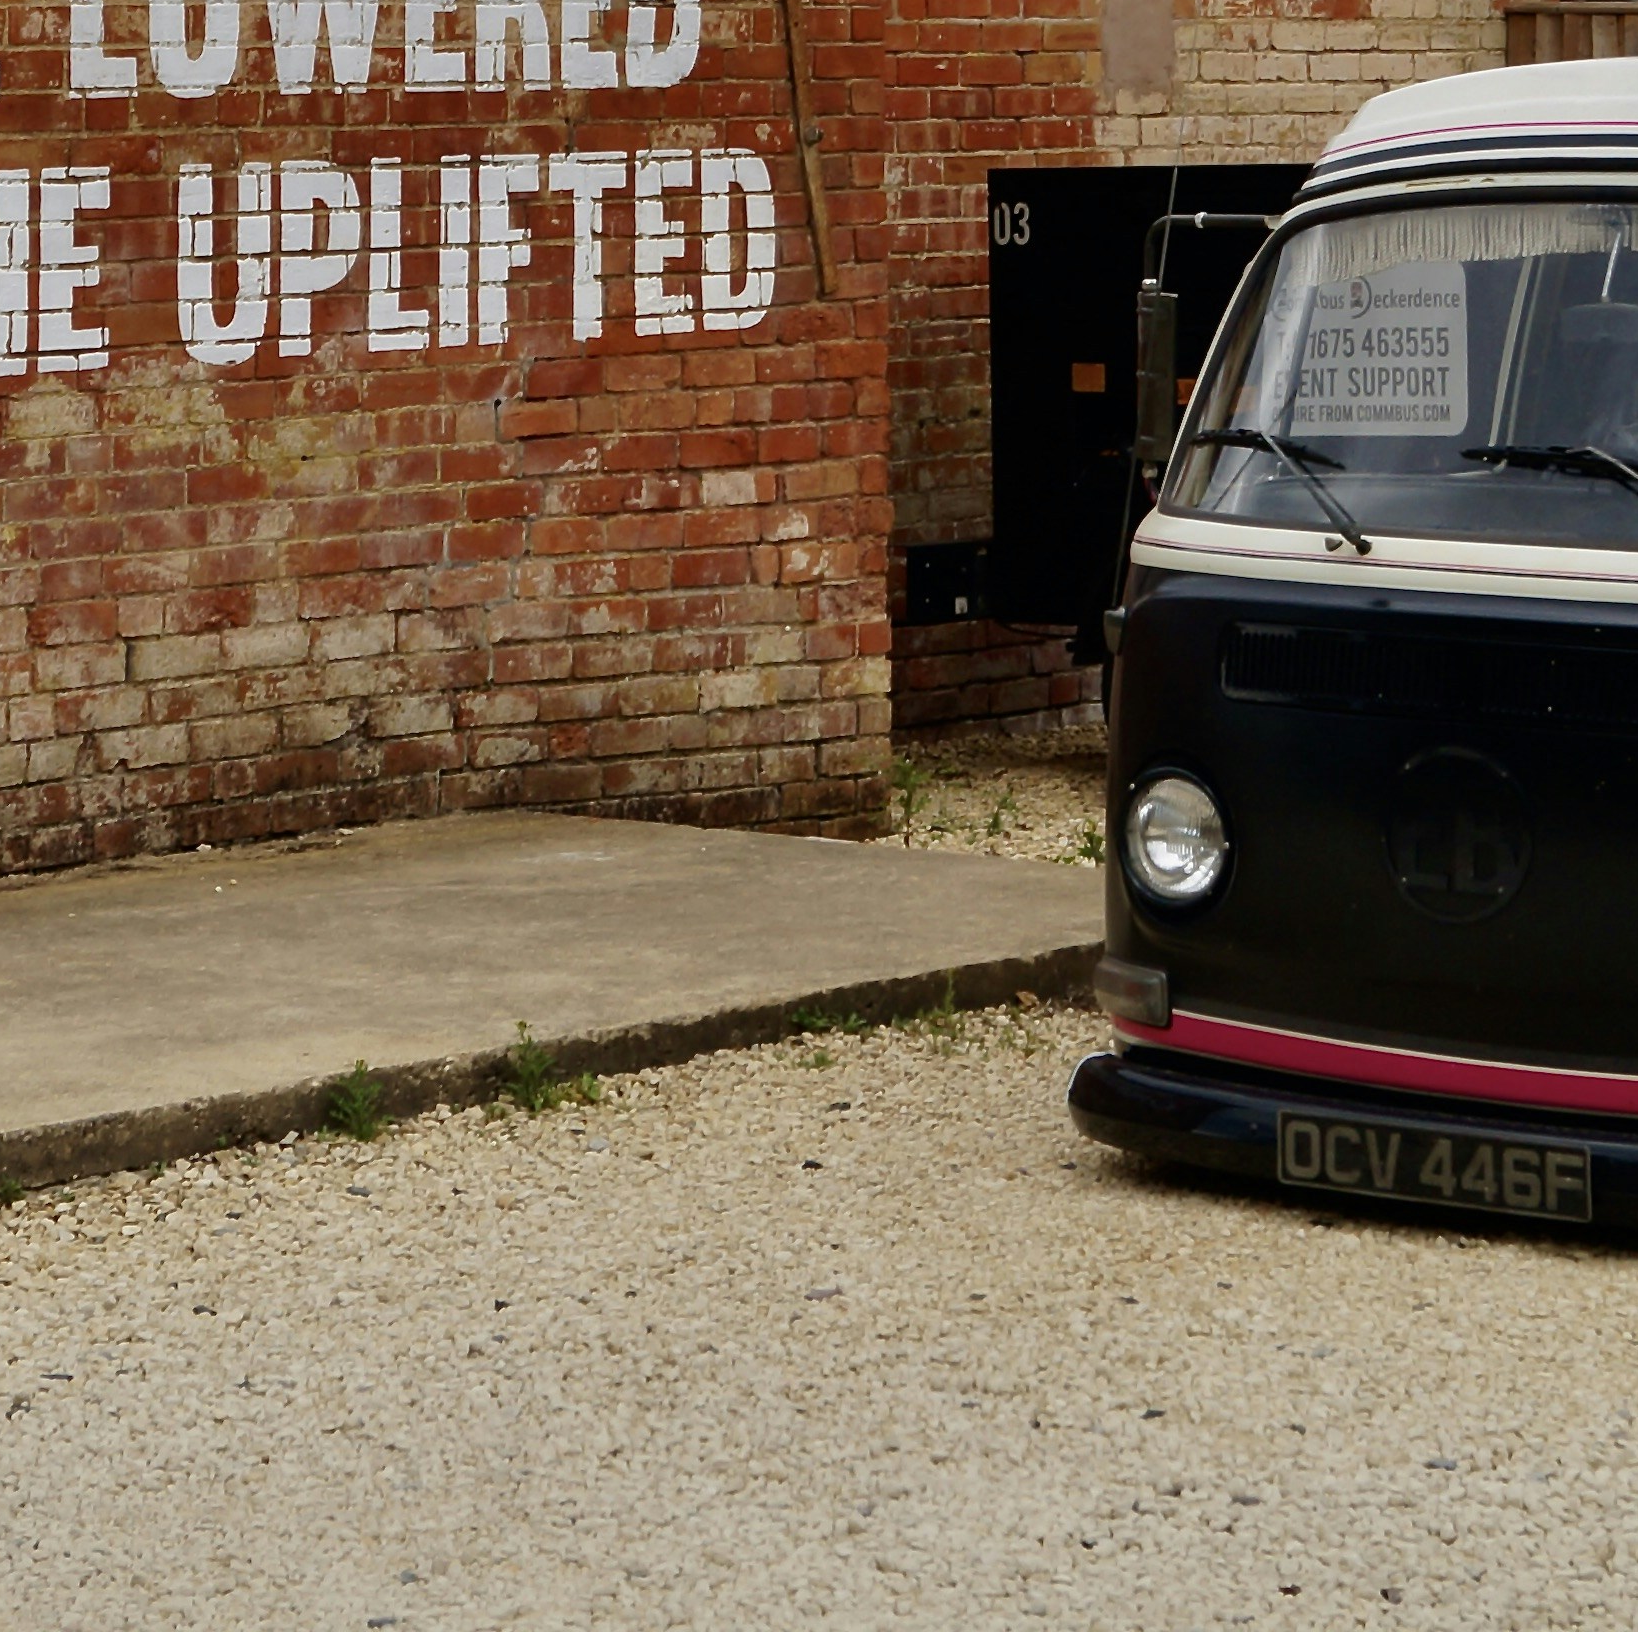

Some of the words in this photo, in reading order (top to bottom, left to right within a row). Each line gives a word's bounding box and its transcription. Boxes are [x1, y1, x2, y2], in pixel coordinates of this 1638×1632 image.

[993, 202, 1031, 245] 03
[178, 148, 777, 366] UPLIFTED
[1361, 326, 1450, 359] 463555
[1274, 366, 1338, 399] EENT
[1348, 366, 1450, 398] SUPPORT
[1294, 404, 1315, 423] IRE
[1319, 404, 1353, 423] FROM
[1357, 403, 1451, 423] COMMBUS.COM
[1284, 1120, 1402, 1191] OCV
[1419, 1137, 1585, 1211] 446F
